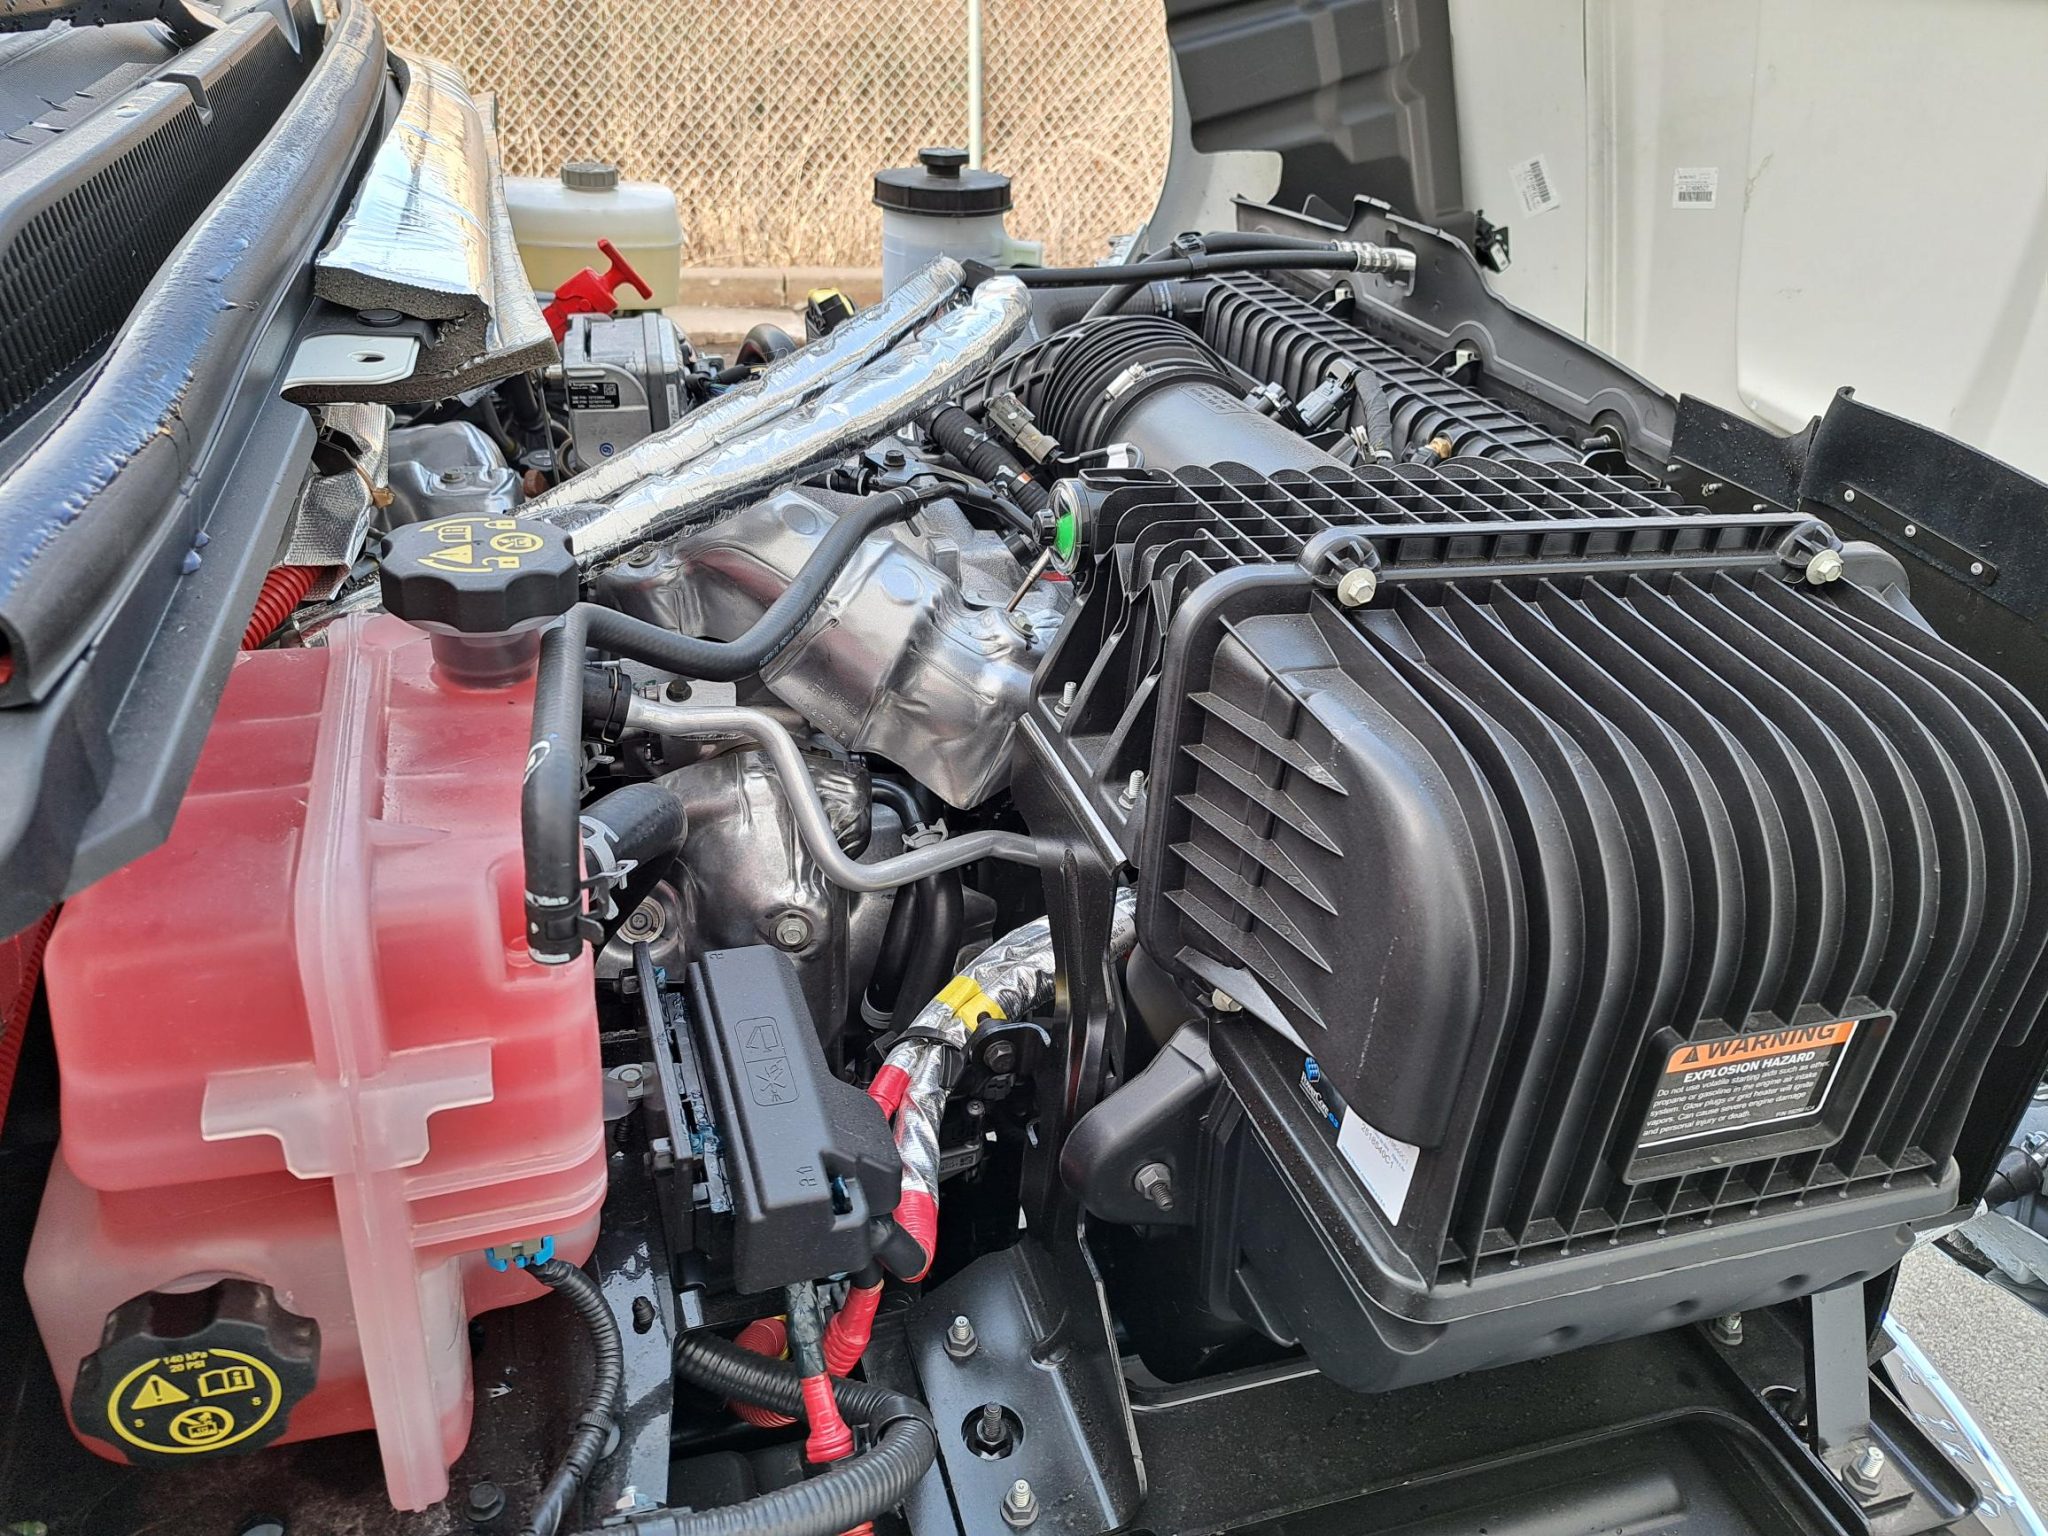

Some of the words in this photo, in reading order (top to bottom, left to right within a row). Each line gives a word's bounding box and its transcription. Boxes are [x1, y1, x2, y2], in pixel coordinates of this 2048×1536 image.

[1708, 1024, 1836, 1059] WARNING
[1657, 1089, 1669, 1097] Do
[1670, 1086, 1684, 1095] not
[1685, 1084, 1701, 1092] use
[1702, 1078, 1730, 1089] volatile
[1731, 1073, 1761, 1084] starting
[1761, 1069, 1778, 1078] aids
[1778, 1065, 1798, 1074] such
[1683, 1060, 1760, 1083] EXPLOSION
[1761, 1051, 1816, 1069] HAZARD
[1649, 1106, 1680, 1118] system.
[1682, 1102, 1704, 1111] Glow
[1703, 1098, 1727, 1107] plugs
[1736, 1092, 1754, 1102] grid
[1752, 1088, 1779, 1098] heater
[1779, 1084, 1794, 1092] will
[1793, 1081, 1815, 1091] ignite
[1652, 1096, 1687, 1109] propane
[1697, 1087, 1732, 1100] gasoline
[1741, 1083, 1755, 1091] the
[1755, 1078, 1782, 1088] engine
[1794, 1072, 1818, 1080] intake
[1646, 1116, 1676, 1127] vapors.
[1695, 1108, 1720, 1117] cause
[1720, 1103, 1747, 1112] severe
[1747, 1098, 1775, 1107] engine
[1775, 1091, 1807, 1102] damage
[1642, 1127, 1660, 1136] and
[1659, 1121, 1695, 1134] personal
[1695, 1117, 1718, 1127] injury
[162, 1354, 184, 1365] 140
[184, 1351, 209, 1361] kPa
[169, 1363, 185, 1373] 20
[185, 1359, 206, 1370] PSI
